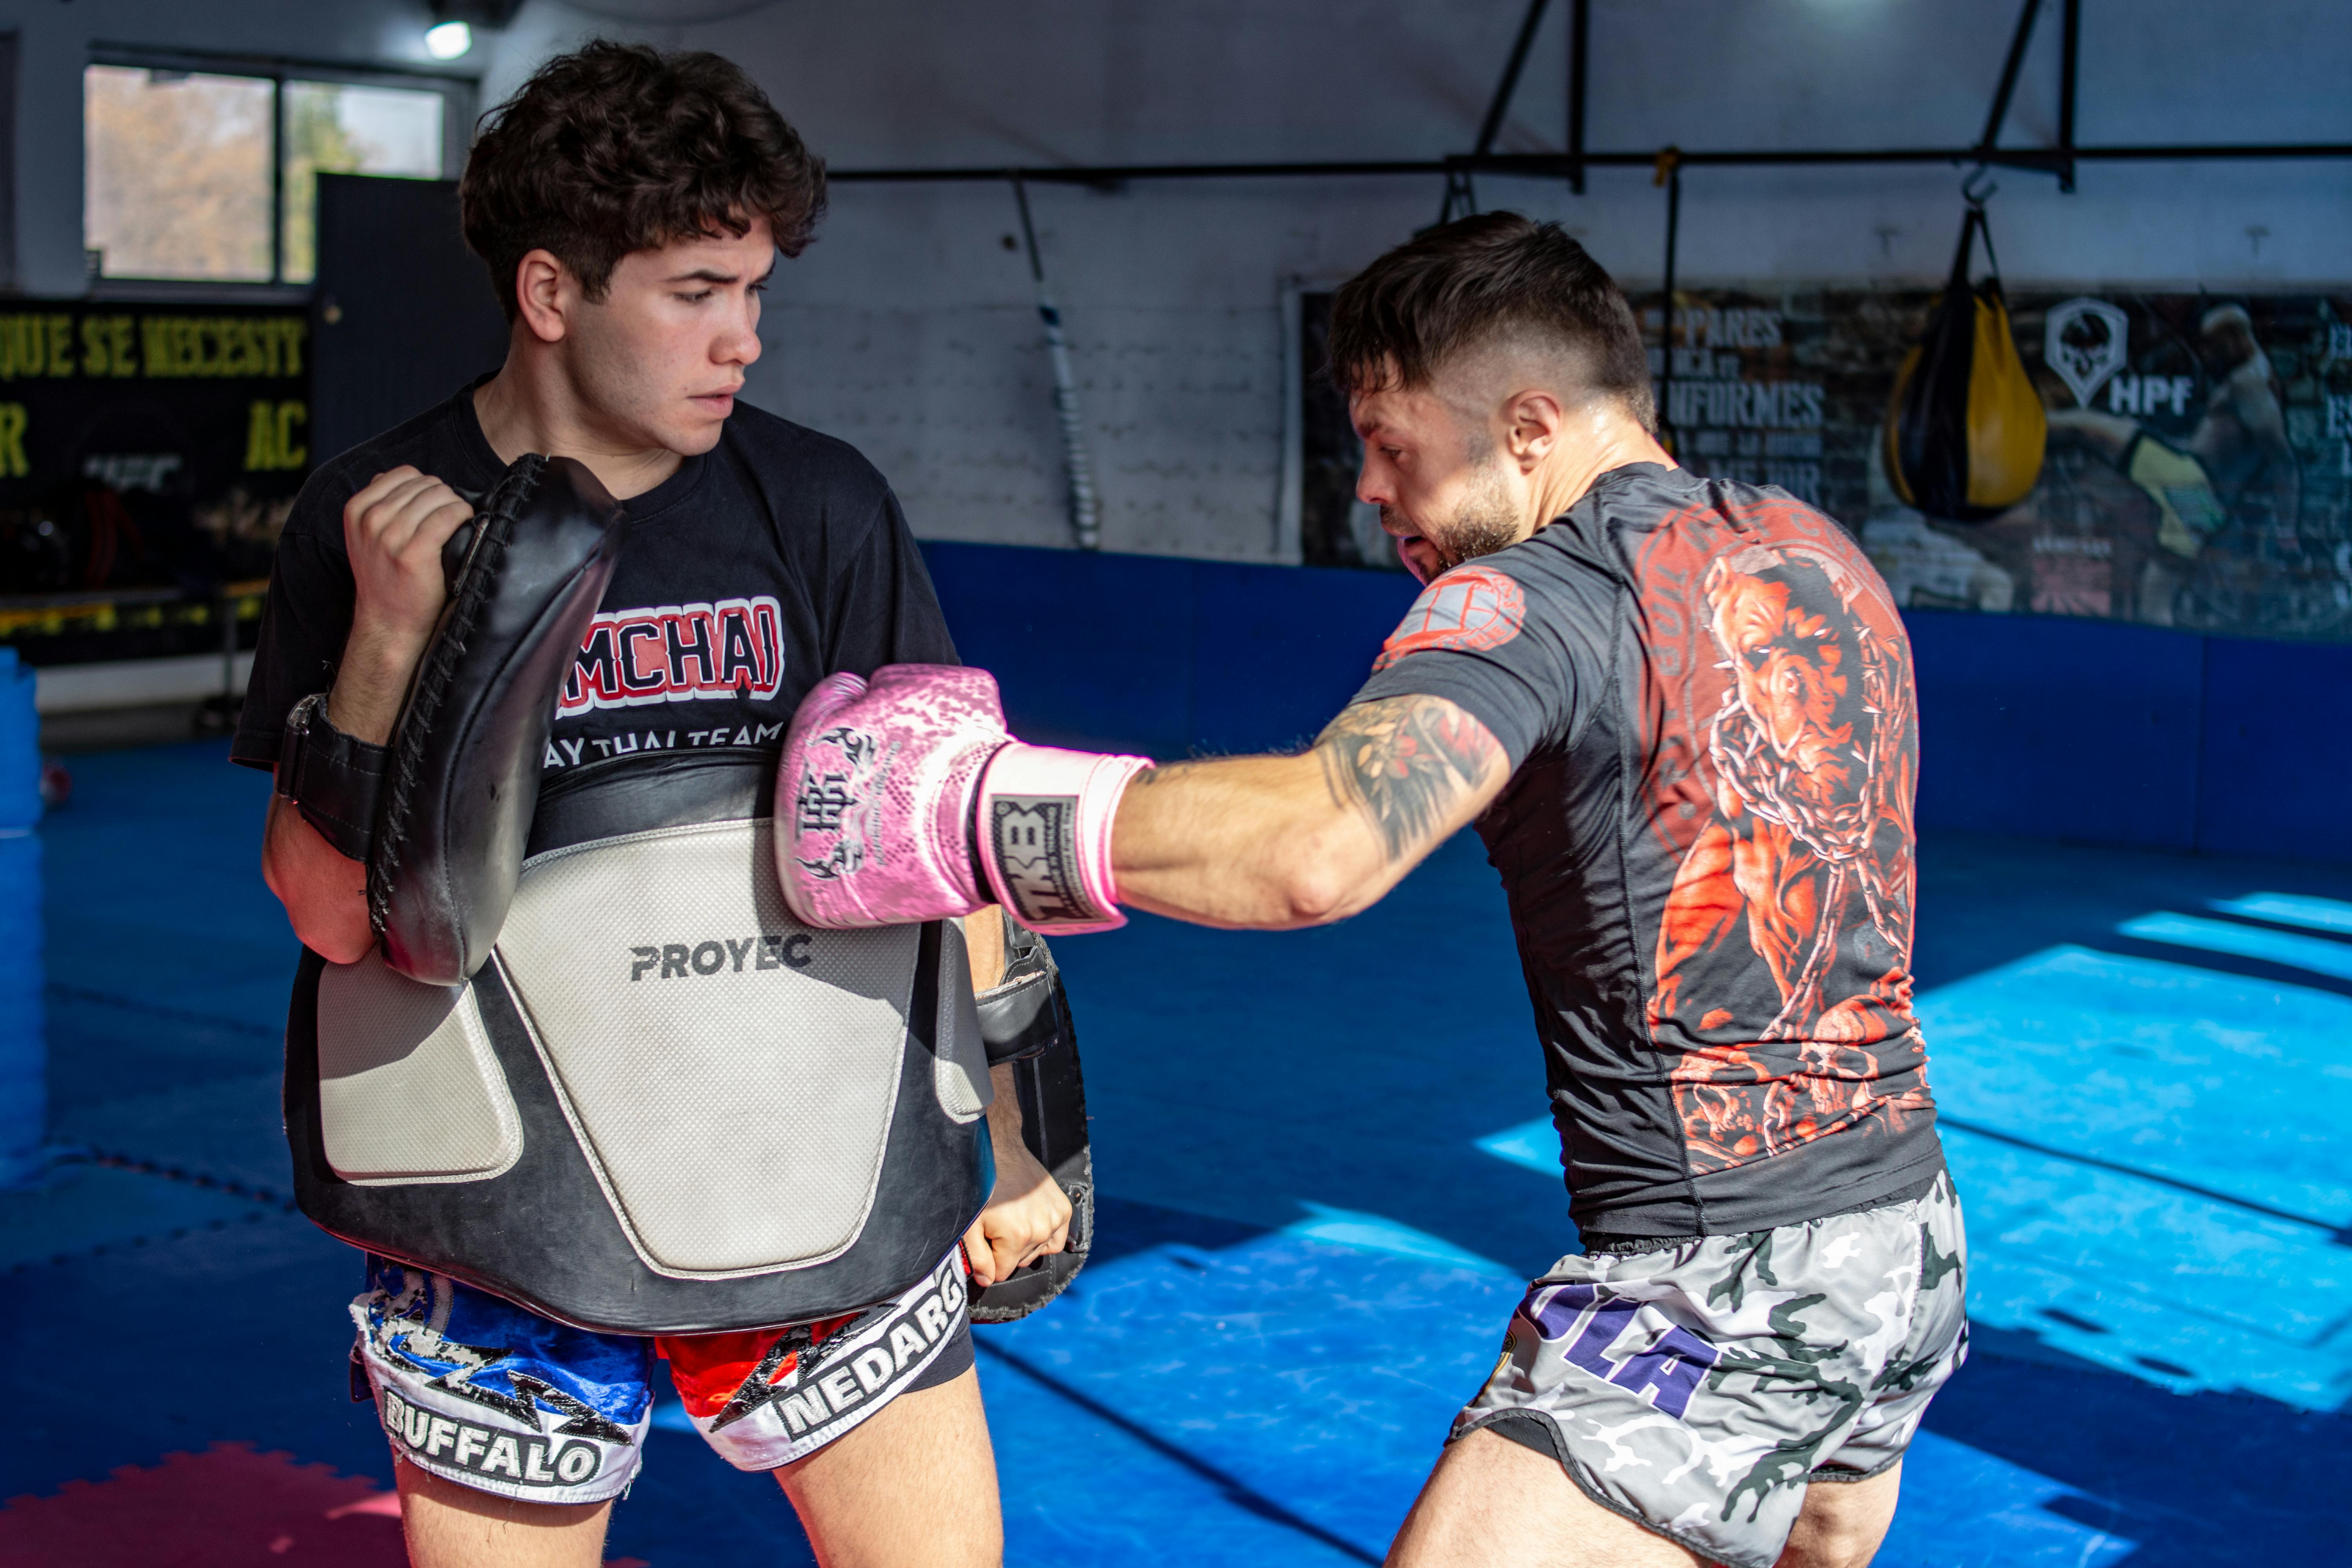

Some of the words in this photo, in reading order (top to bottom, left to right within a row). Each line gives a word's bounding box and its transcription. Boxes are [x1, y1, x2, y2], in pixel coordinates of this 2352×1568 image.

[81, 314, 137, 377] SE
[1655, 379, 1826, 428] NFORMES
[2110, 375, 2192, 416] HPF
[688, 721, 784, 746] TEAM
[629, 933, 813, 981] PROYEC
[782, 1269, 963, 1434] NEDARG
[386, 1391, 597, 1483] BUFFALO
